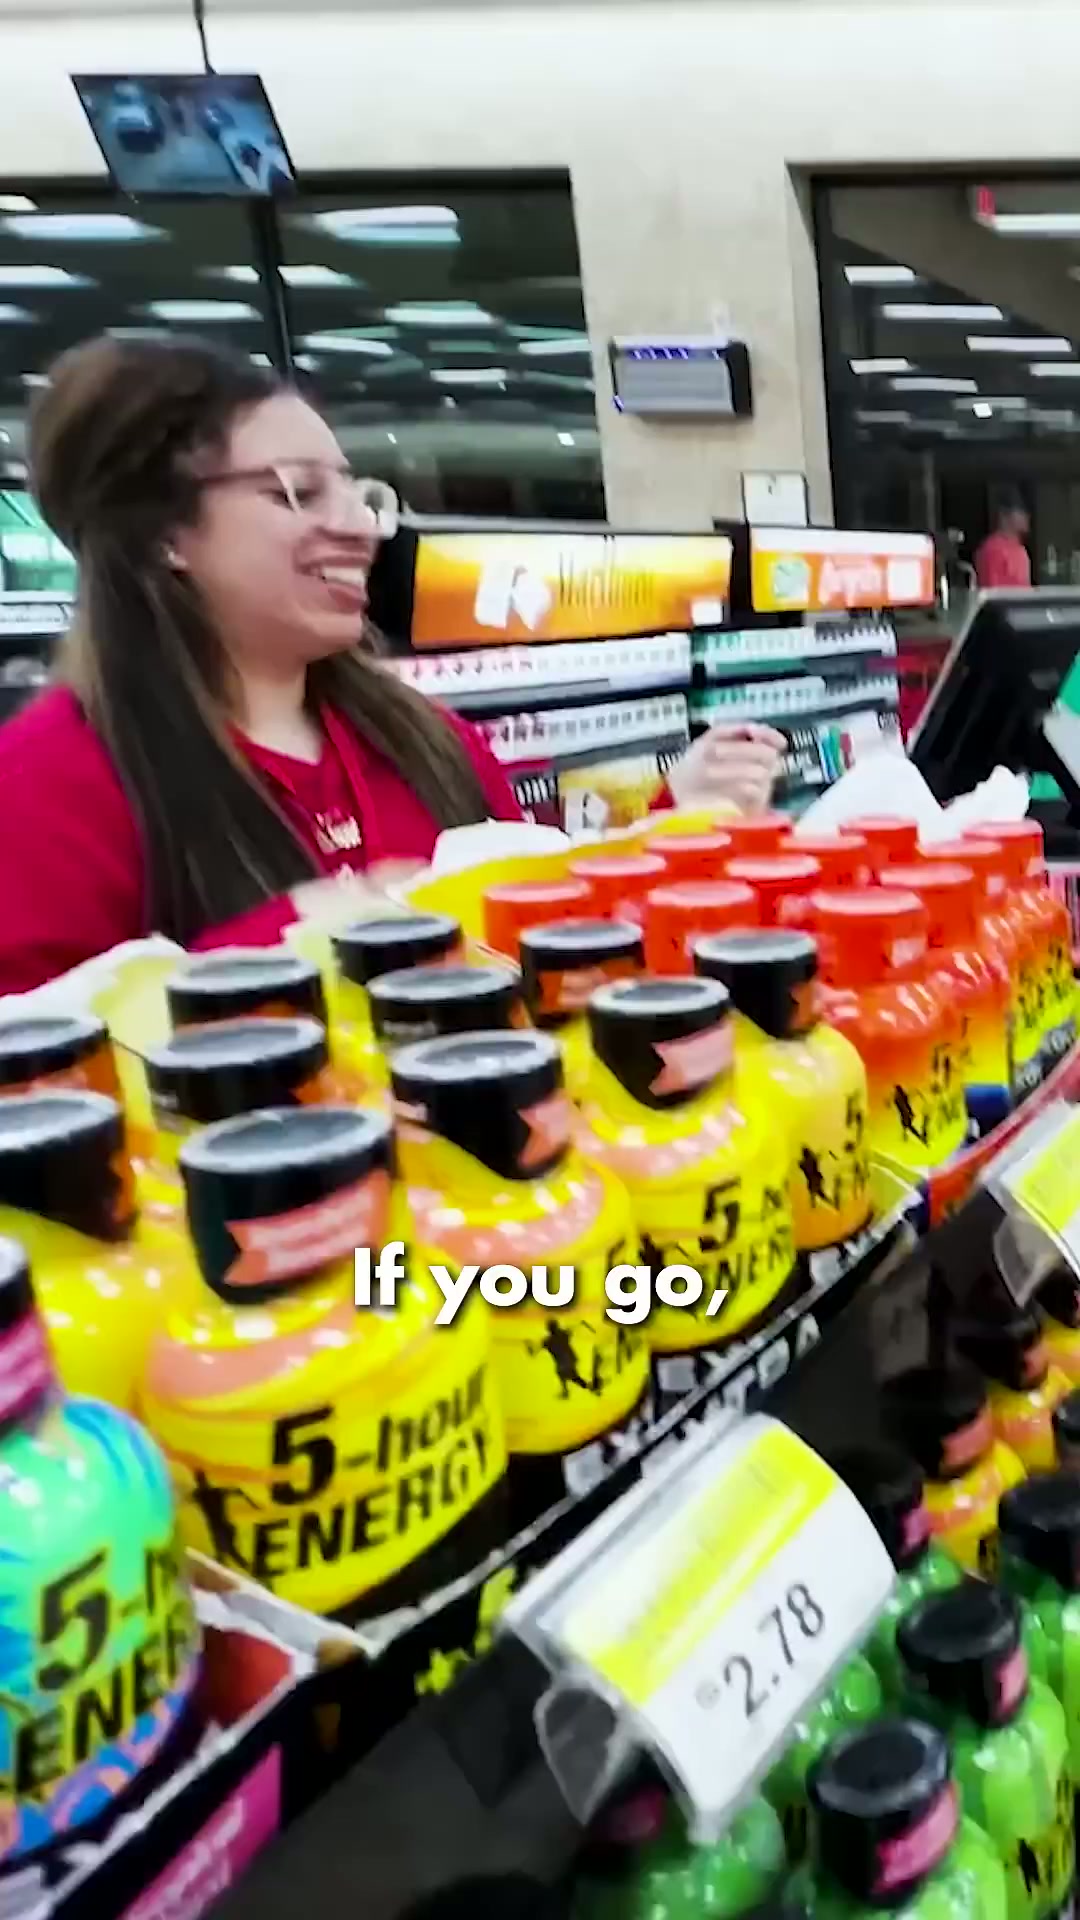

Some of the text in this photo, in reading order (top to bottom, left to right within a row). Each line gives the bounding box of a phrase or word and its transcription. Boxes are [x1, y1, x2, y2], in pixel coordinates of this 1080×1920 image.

[252, 1425, 488, 1580] ENERGY
[270, 1364, 486, 1506] 5-hour
[722, 1583, 824, 1719] 2.78
